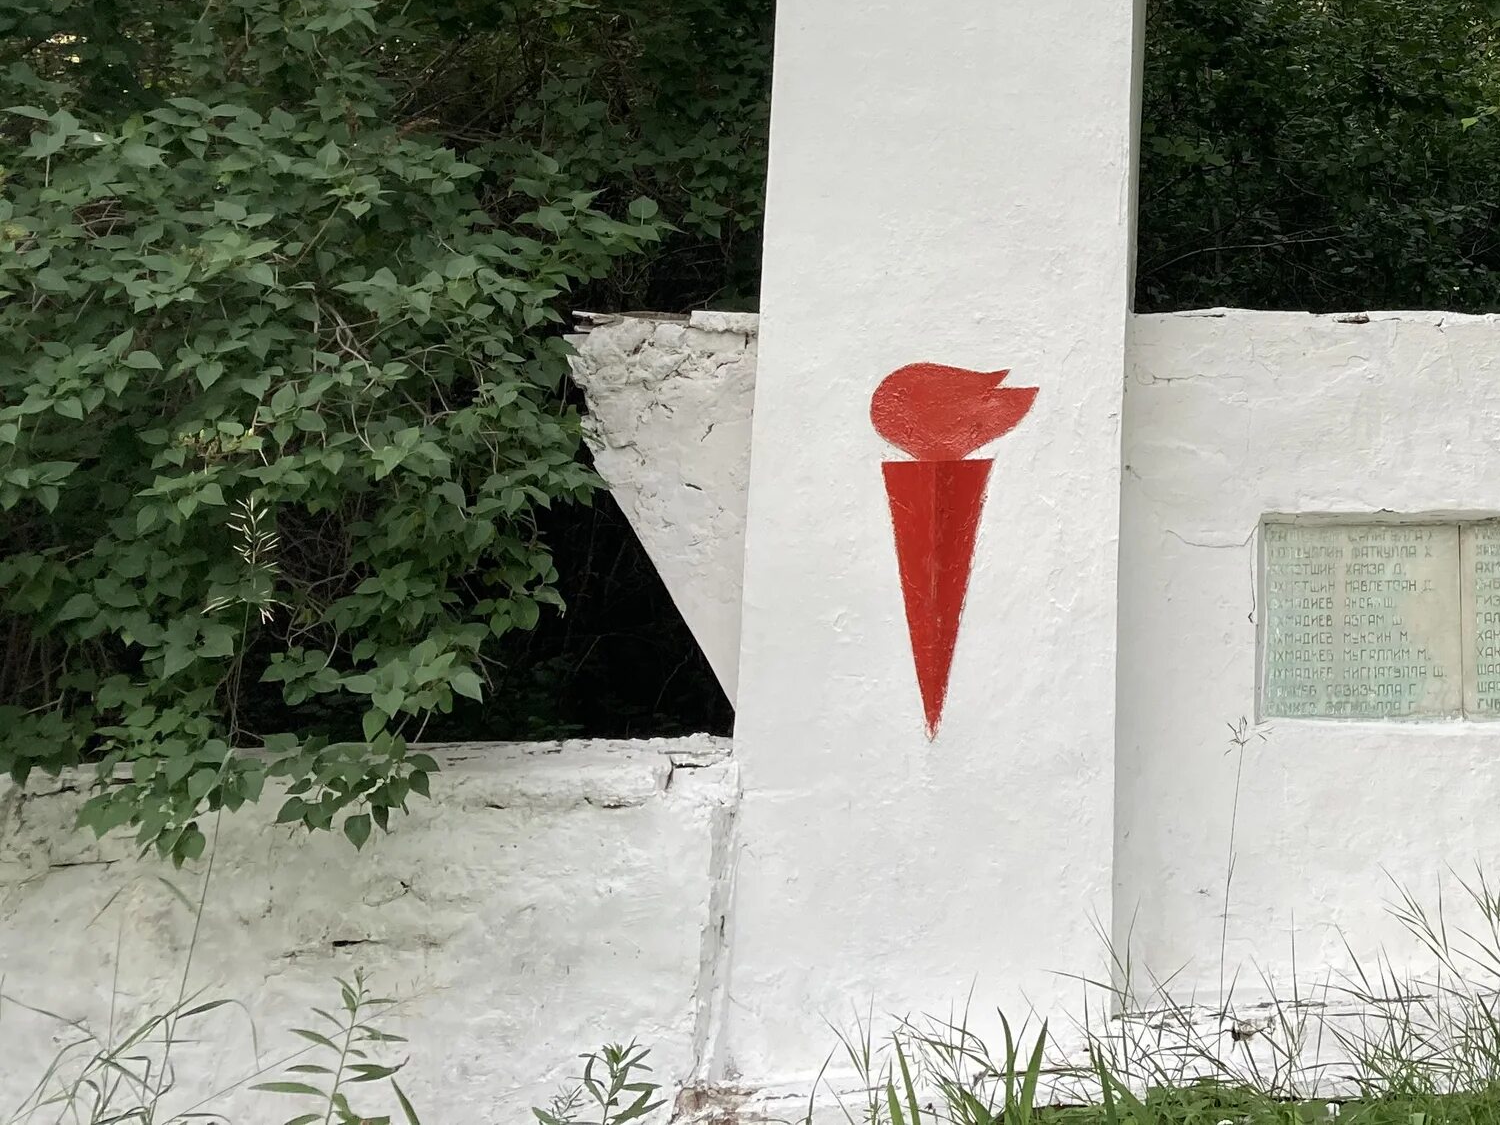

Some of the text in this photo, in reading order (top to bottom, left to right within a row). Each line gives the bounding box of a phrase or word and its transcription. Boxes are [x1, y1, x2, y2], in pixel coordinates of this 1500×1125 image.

[1346, 564, 1384, 576] ХАМЗА
[1344, 632, 1391, 644] МУКСИН
[1343, 649, 1409, 662] МУГАЛЛИМ
